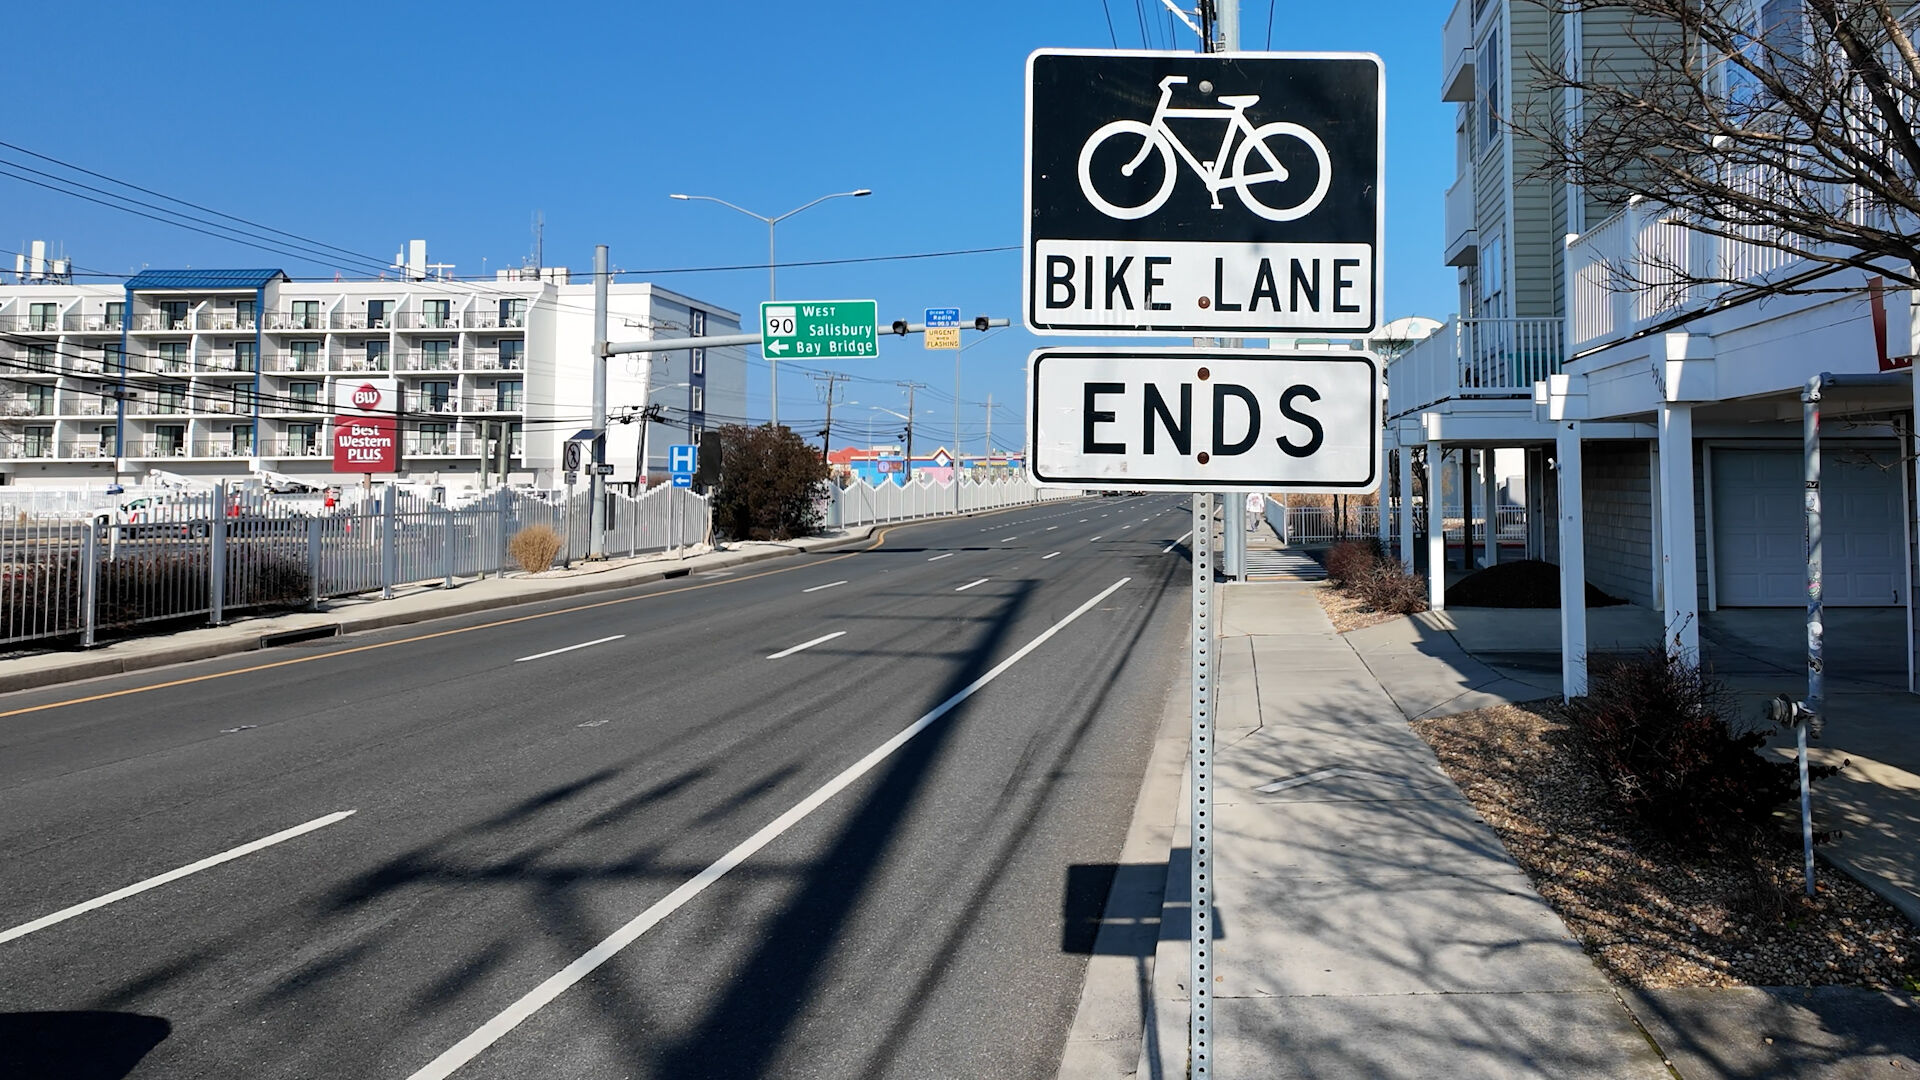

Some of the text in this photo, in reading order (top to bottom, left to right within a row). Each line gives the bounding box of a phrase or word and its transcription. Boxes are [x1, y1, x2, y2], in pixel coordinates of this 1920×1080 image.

[1045, 255, 1360, 313] BIKE LANE
[802, 305, 836, 317] WEST
[769, 318, 794, 334] 90
[809, 323, 872, 339] Salisbury
[796, 340, 873, 356] Bay Bridge
[355, 391, 378, 404] BW
[1083, 382, 1324, 458] ENDS
[352, 424, 380, 436] Best
[338, 435, 391, 447] Western
[672, 446, 693, 472] H
